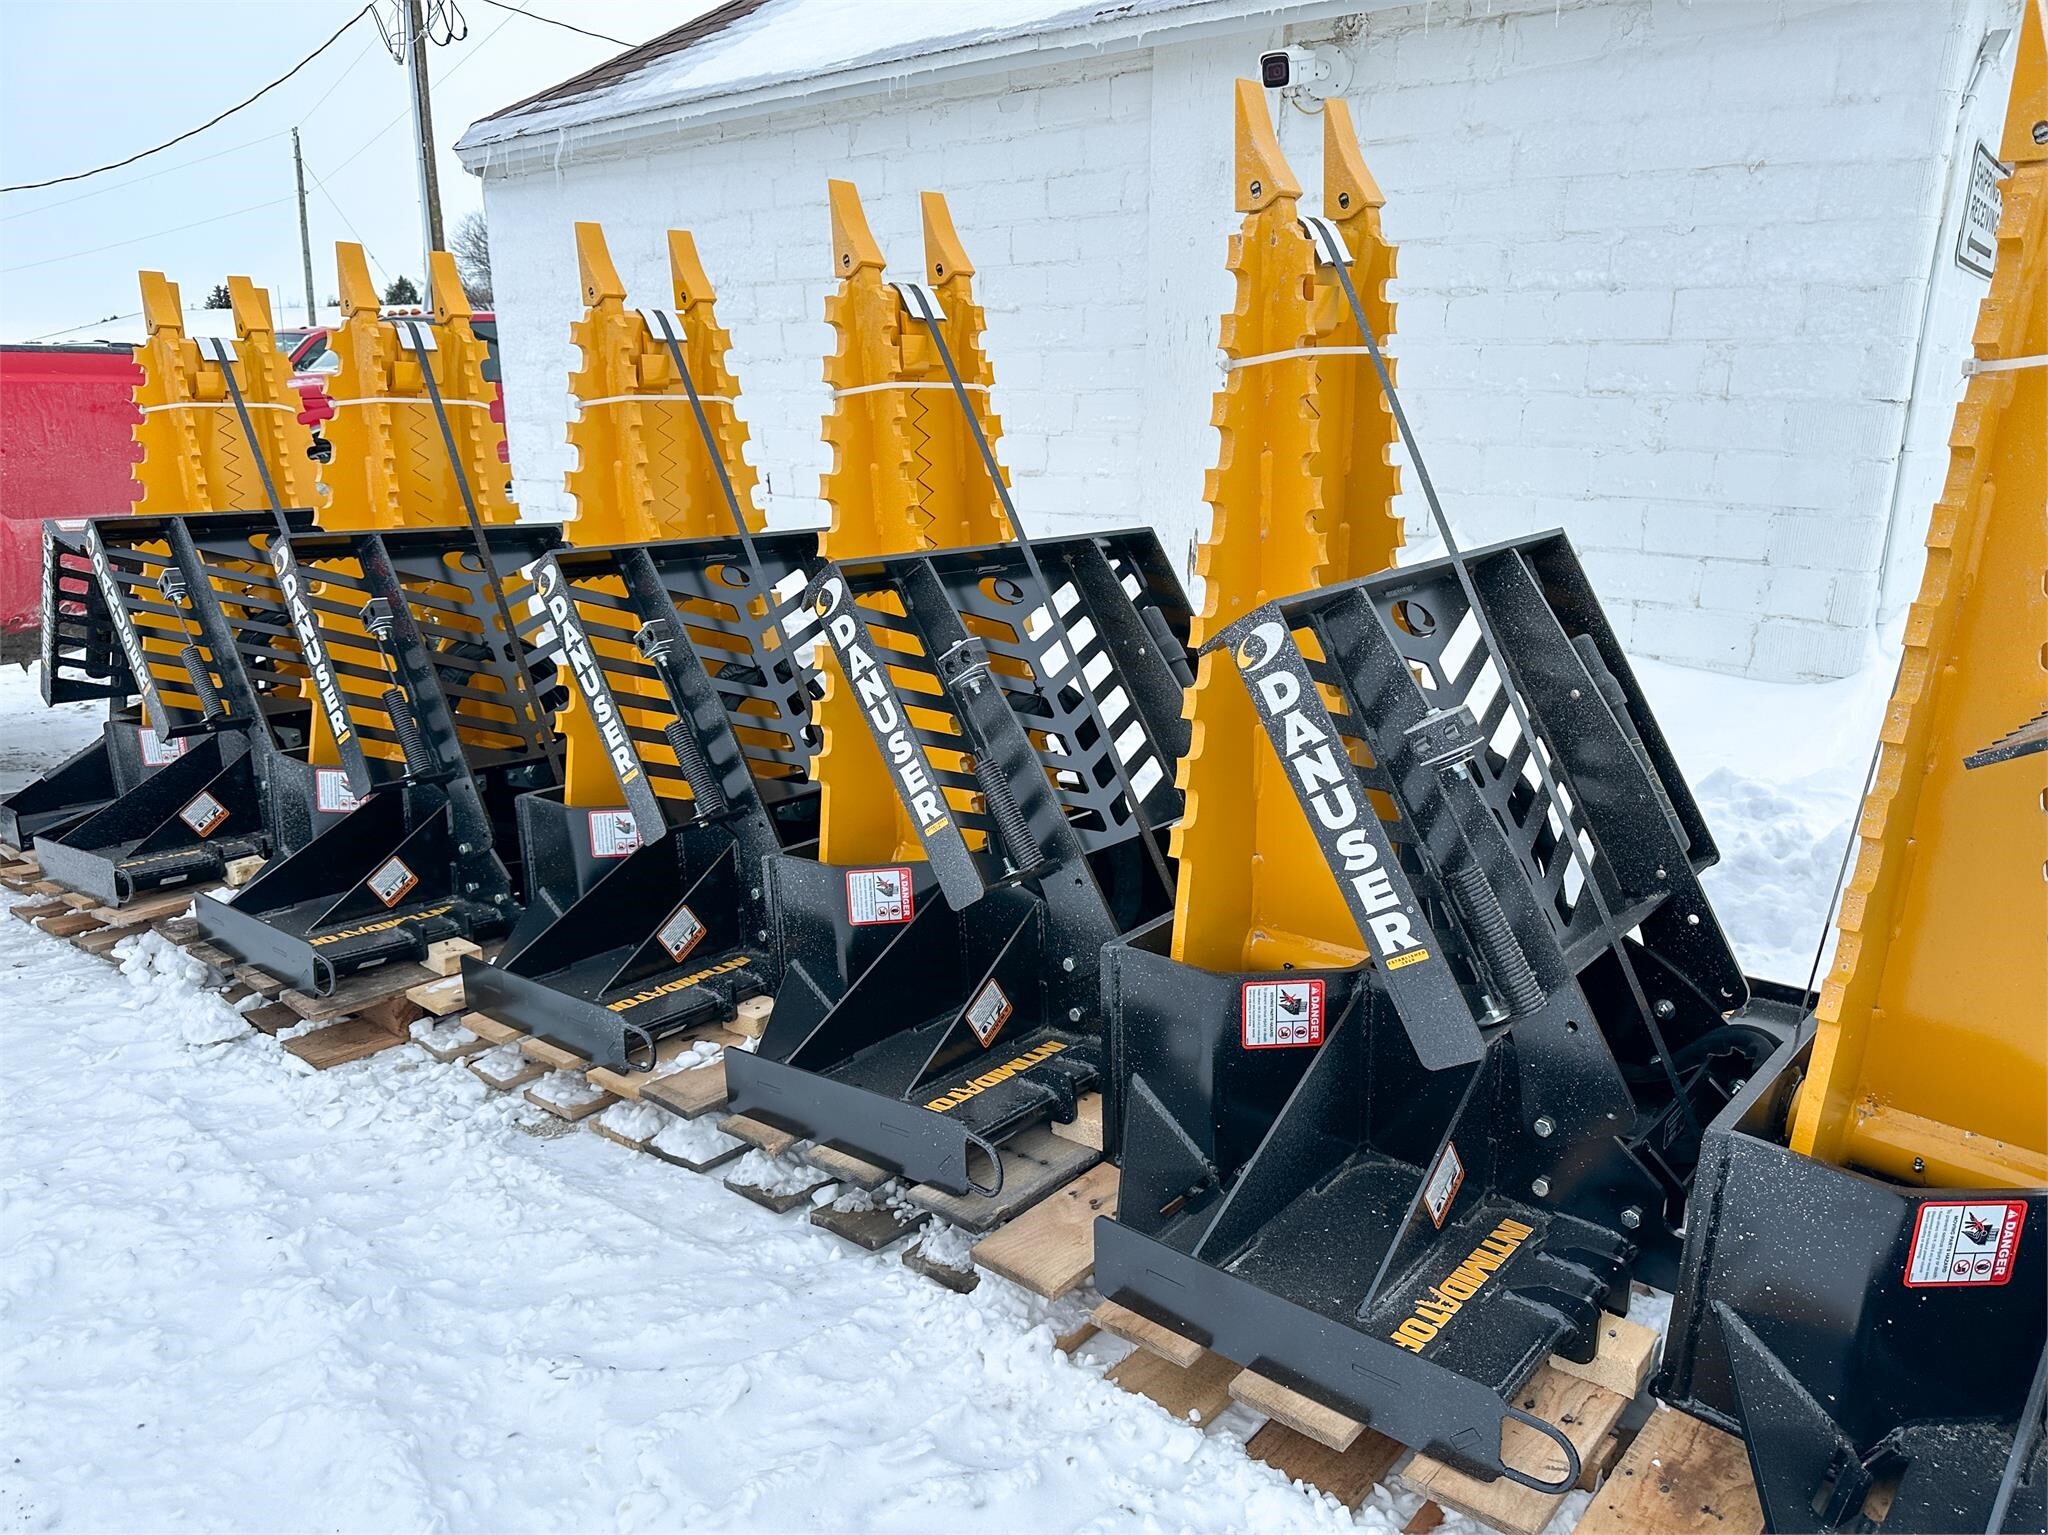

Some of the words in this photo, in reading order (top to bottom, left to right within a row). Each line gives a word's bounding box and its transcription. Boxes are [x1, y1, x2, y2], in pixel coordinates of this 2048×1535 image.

[92, 553, 150, 690] DANUSER
[283, 574, 348, 737] DANUSER
[549, 596, 636, 776] DANUSER
[829, 615, 945, 827] DANUSER
[1257, 671, 1422, 956] DANUSER
[901, 880, 910, 916] DANGER
[923, 1040, 1068, 1112] INTIMIDATO
[1310, 996, 1318, 1039] DANGER
[1994, 1225, 2017, 1276] DANGER
